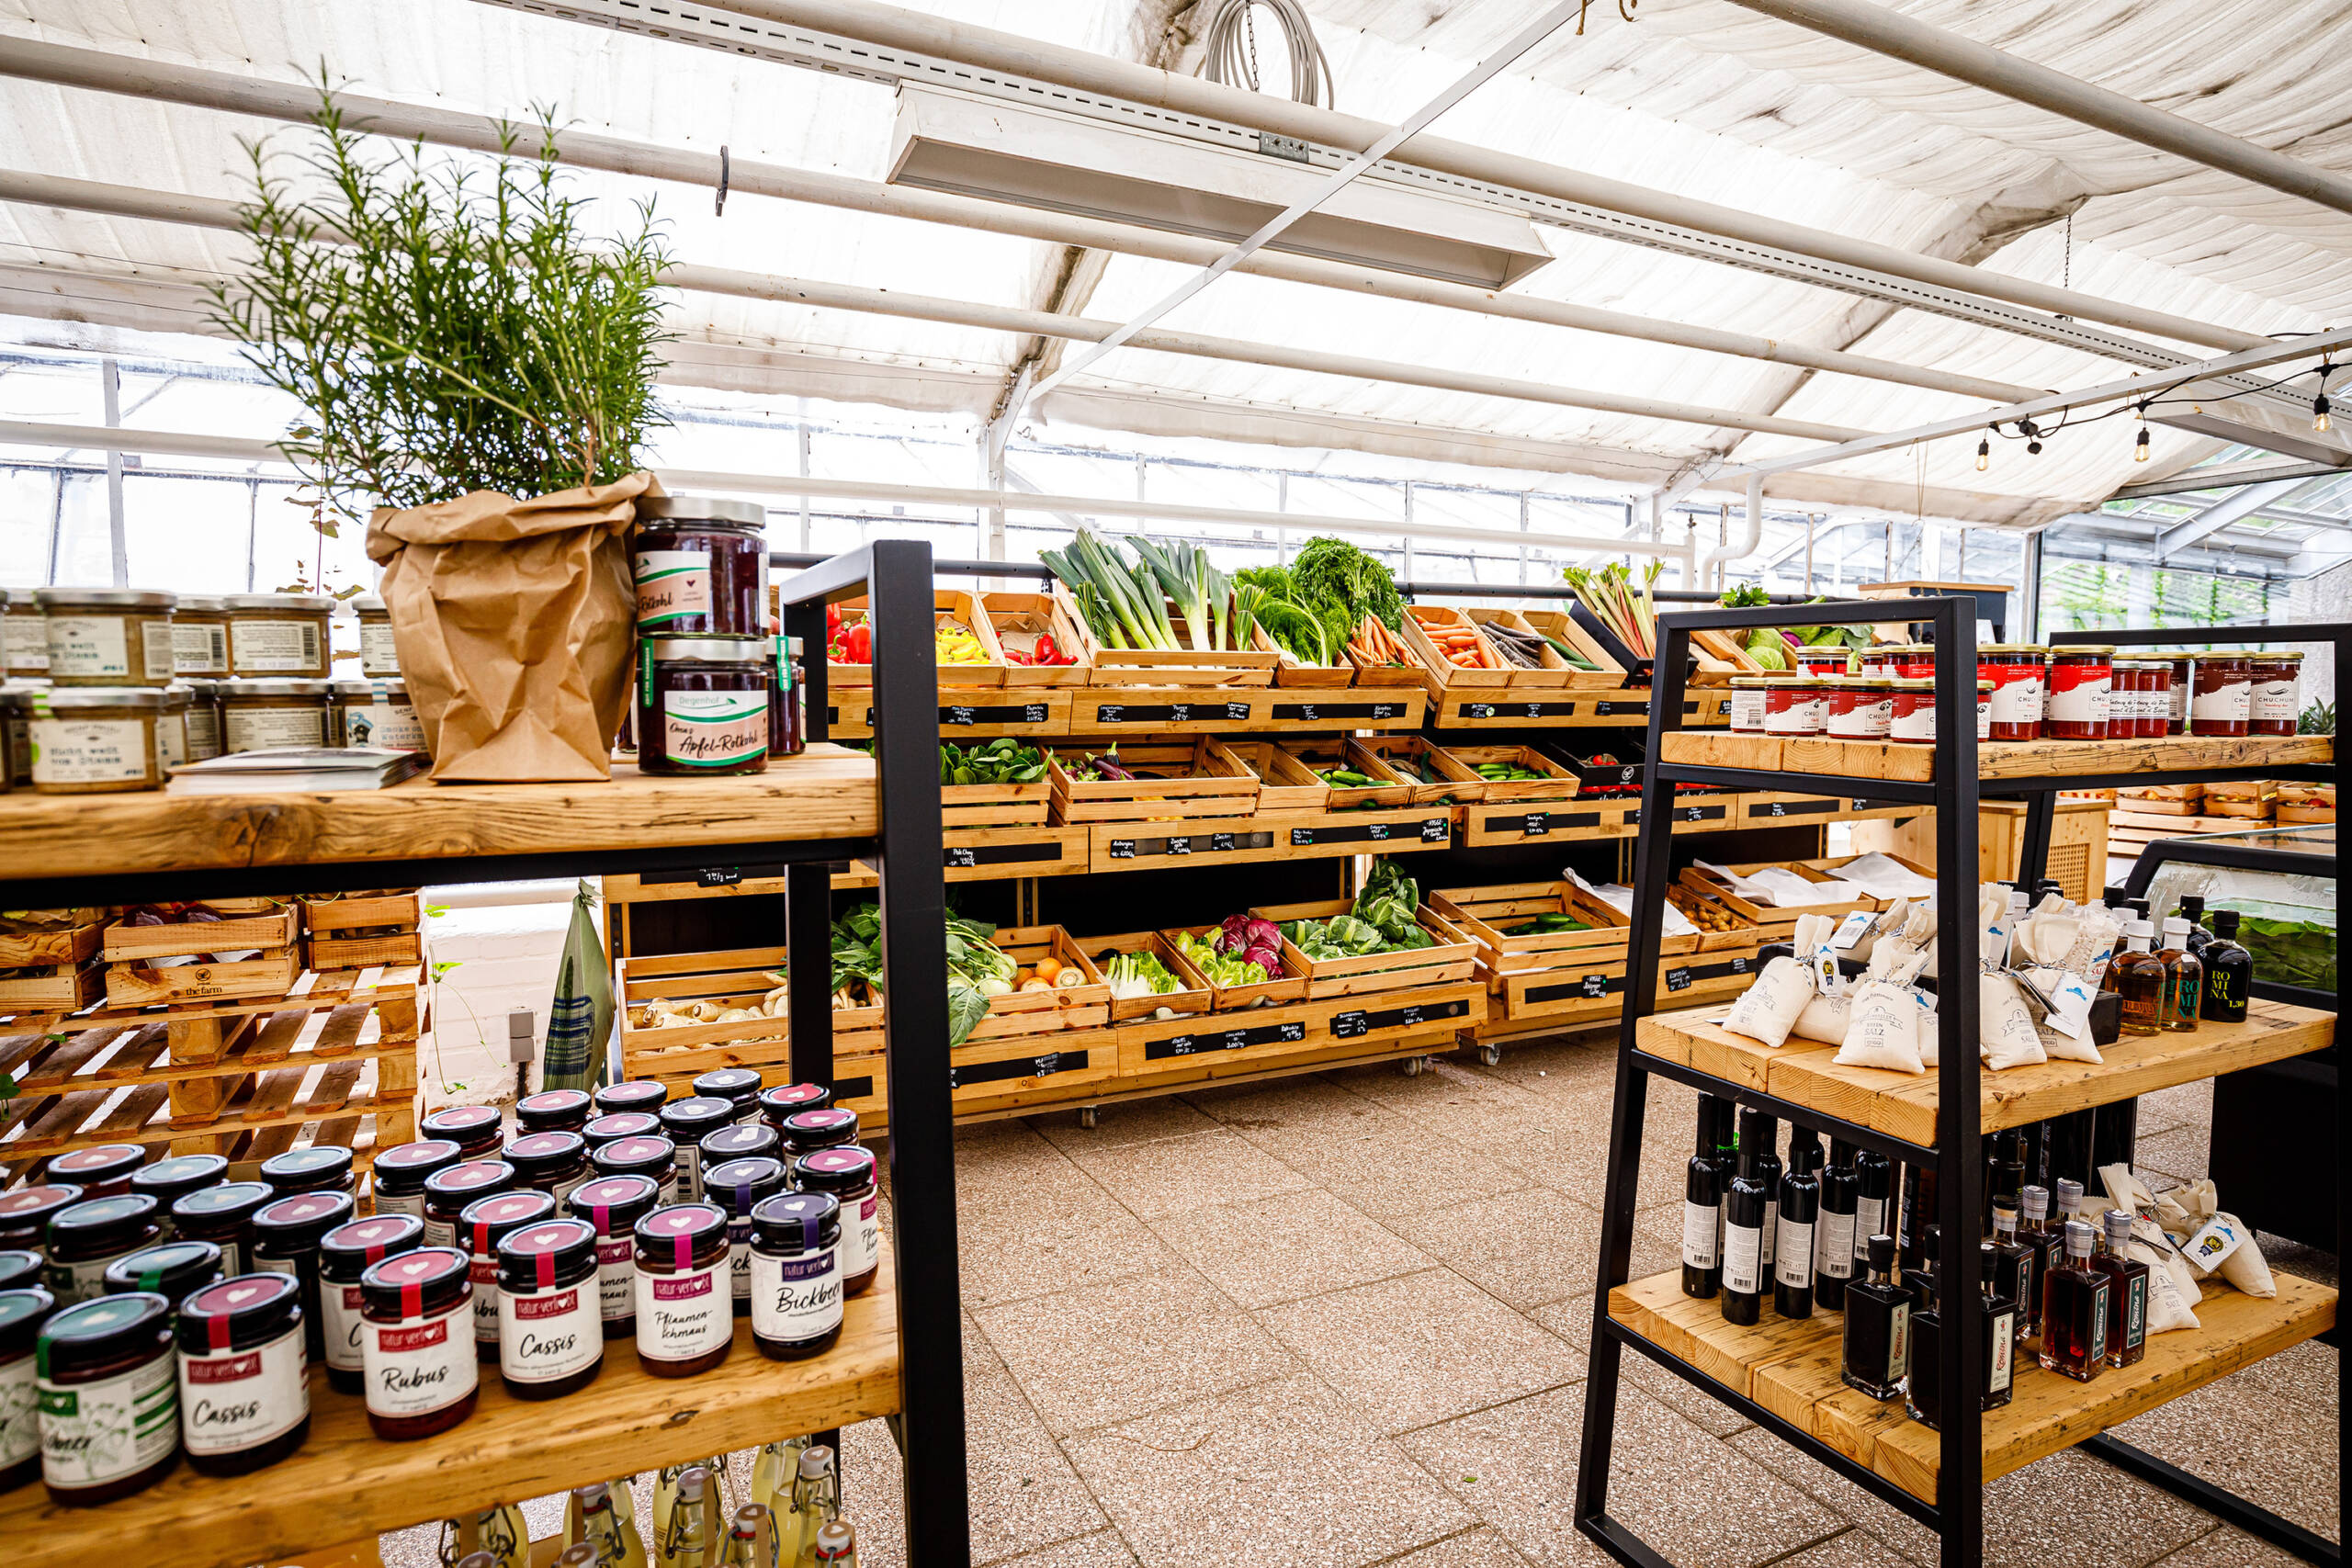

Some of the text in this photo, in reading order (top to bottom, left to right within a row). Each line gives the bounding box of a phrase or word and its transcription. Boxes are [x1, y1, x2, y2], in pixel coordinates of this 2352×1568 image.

[2211, 970, 2231, 981] RO
[187, 986, 223, 996] the farm
[2179, 979, 2199, 994] RO
[2211, 980, 2228, 990] MI
[2178, 994, 2198, 1007] MI
[2211, 989, 2229, 999] NA
[2177, 1008, 2197, 1020] NA
[2132, 1294, 2140, 1331] Romina
[2096, 1306, 2104, 1342] Romina
[520, 1333, 577, 1359] Cassis
[380, 1364, 448, 1393] Rubus
[191, 1398, 262, 1429] Cassis
